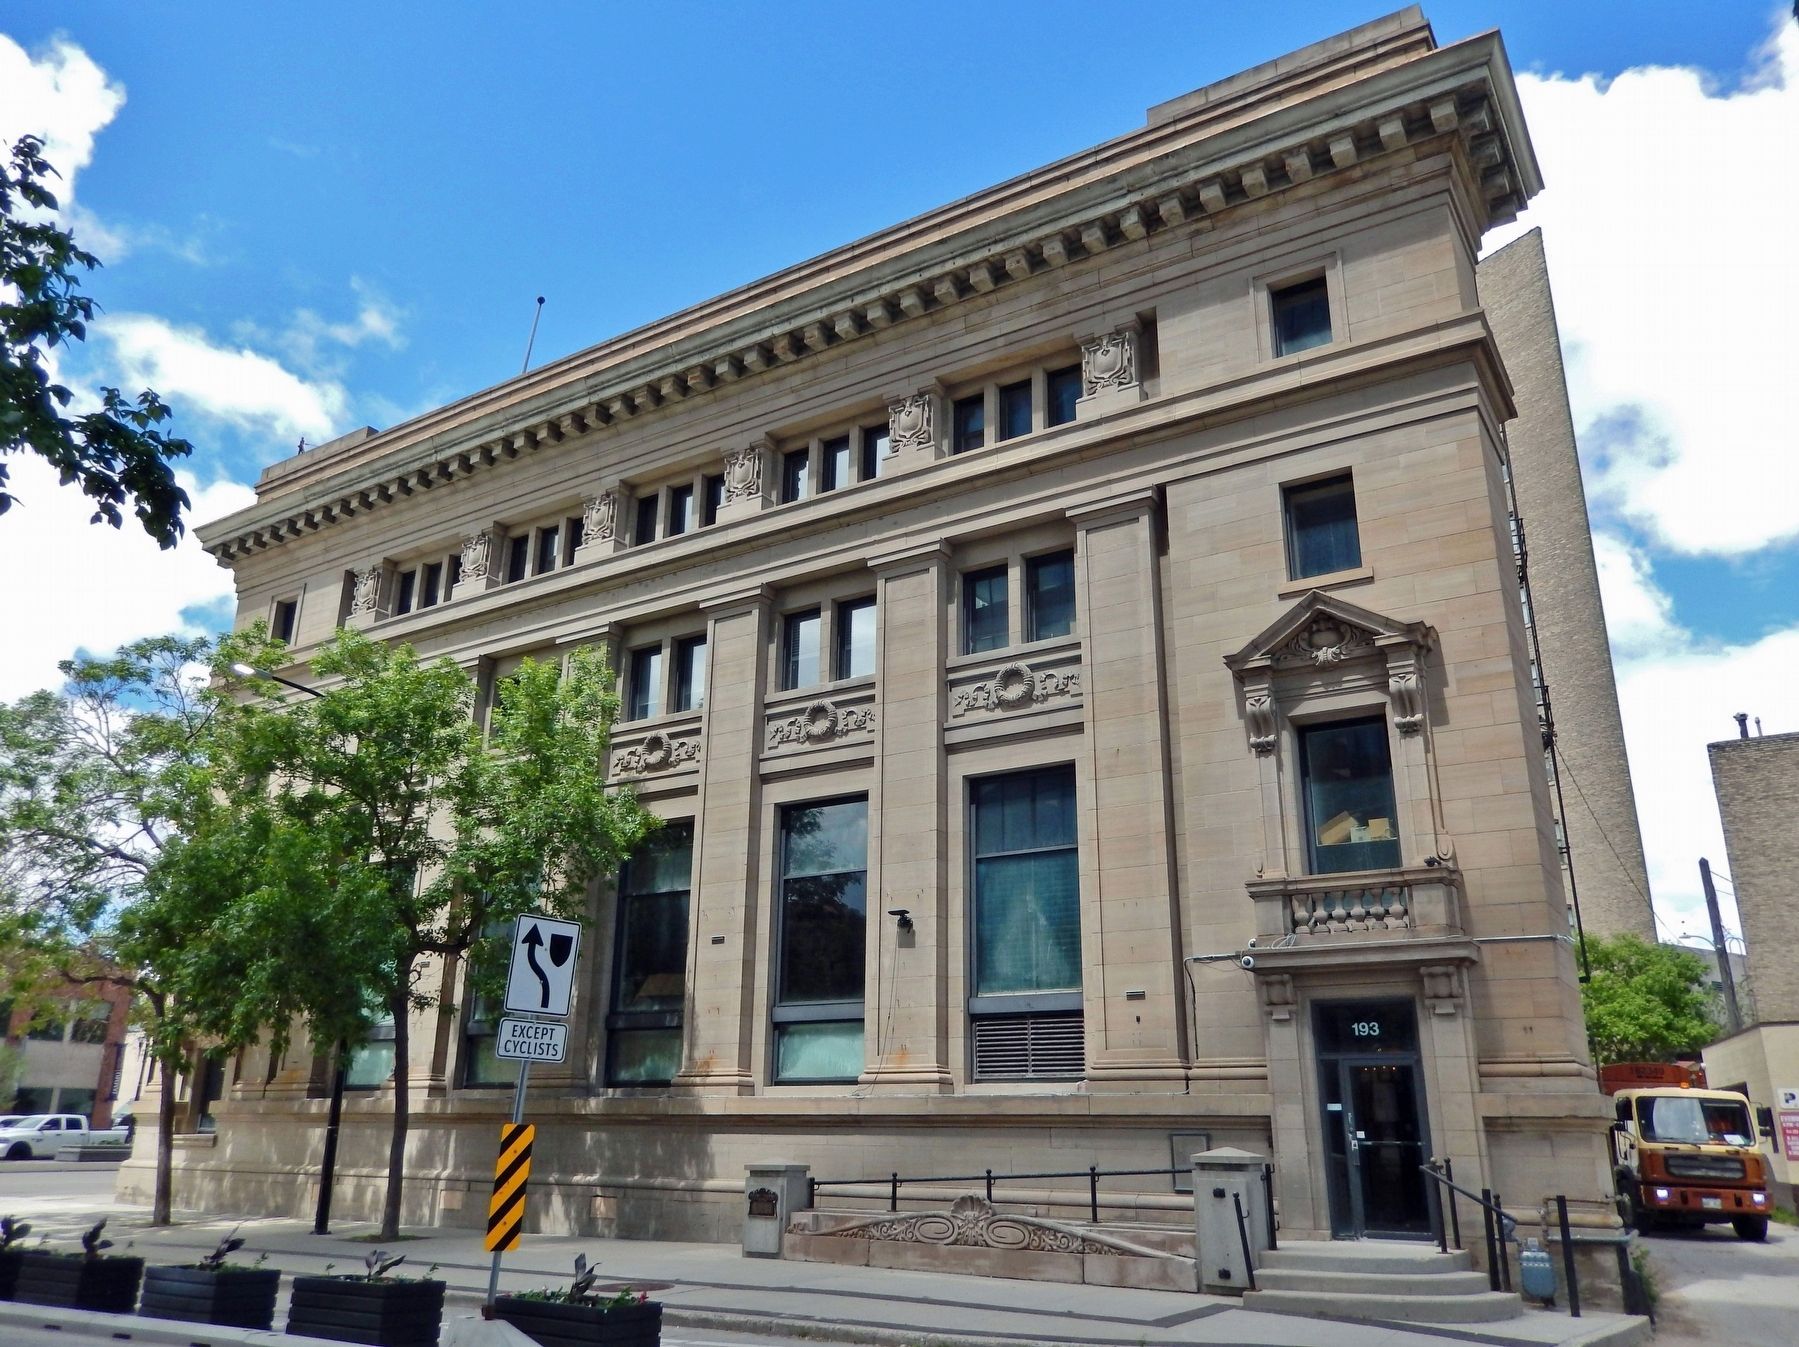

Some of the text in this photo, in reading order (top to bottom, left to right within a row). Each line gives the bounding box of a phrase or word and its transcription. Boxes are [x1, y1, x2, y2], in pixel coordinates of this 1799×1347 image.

[511, 1024, 555, 1041] EXCEPT
[1351, 1022, 1380, 1036] 193
[504, 1040, 559, 1057] CYCLISTS
